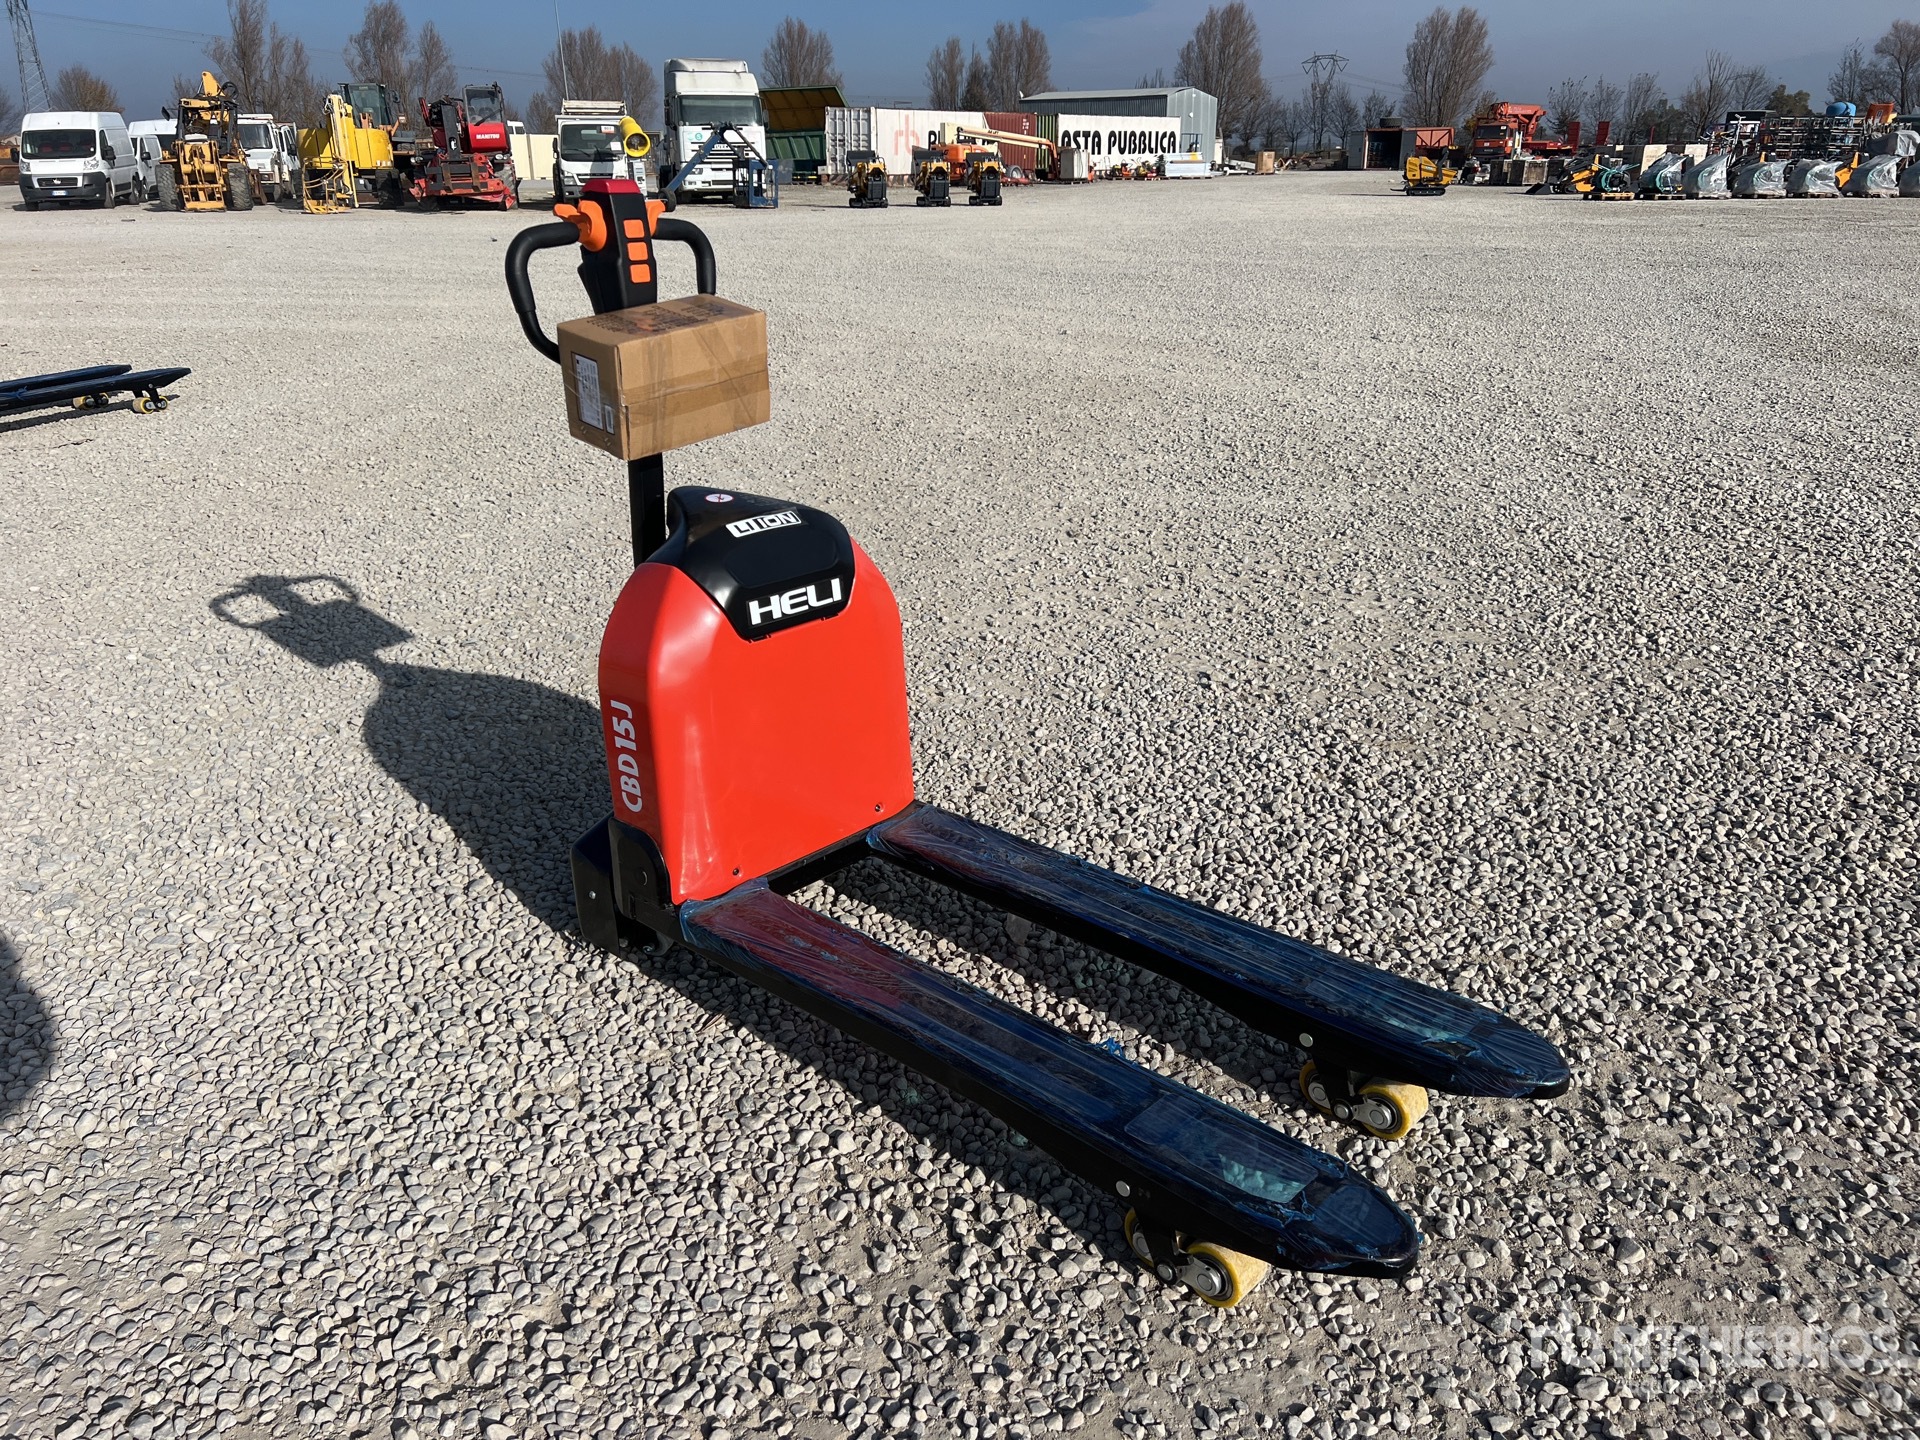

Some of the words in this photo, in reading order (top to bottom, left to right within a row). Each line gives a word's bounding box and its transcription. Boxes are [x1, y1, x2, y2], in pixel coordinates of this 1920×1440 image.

[893, 114, 920, 156] rb
[1060, 129, 1102, 155] ASTA
[1107, 129, 1177, 155] PUBBLICA
[748, 577, 842, 626] HELI
[610, 699, 643, 813] CBD15J
